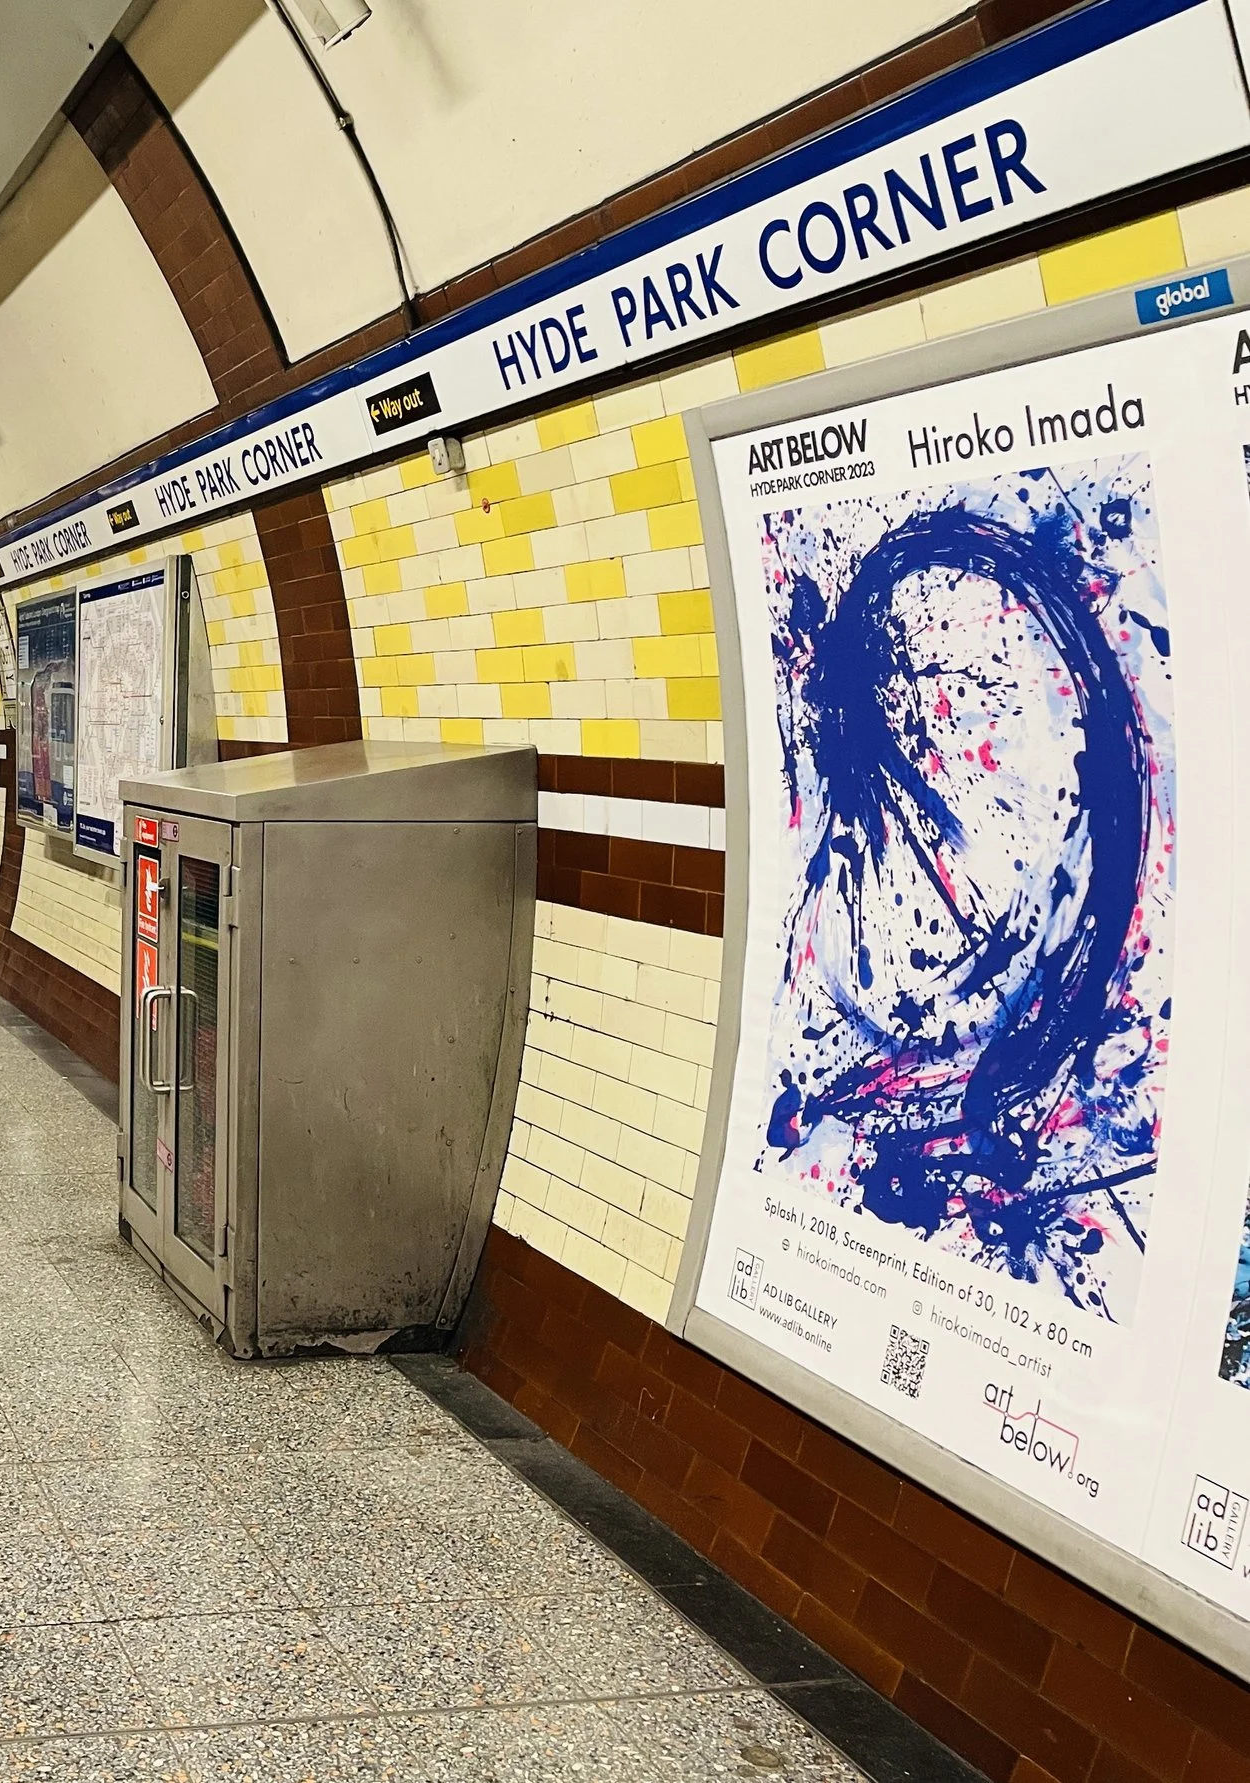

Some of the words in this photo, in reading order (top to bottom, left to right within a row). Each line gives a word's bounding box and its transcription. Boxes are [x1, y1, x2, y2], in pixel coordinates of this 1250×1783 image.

[493, 304, 598, 390] HYDE
[612, 245, 740, 348] PARK
[759, 118, 1048, 290] CORNER
[1156, 277, 1210, 316] global
[379, 399, 402, 421] Way
[403, 389, 424, 411] out
[908, 412, 1014, 468] Hiroko
[1026, 384, 1145, 446] Imada
[155, 476, 196, 518] HYDE
[196, 457, 241, 503] PARK
[242, 423, 323, 485] CORNER
[748, 437, 786, 475] ART
[787, 419, 868, 466] BELOW
[750, 482, 777, 498] HYDE
[777, 474, 802, 492] PARK
[803, 468, 846, 488] CORNER
[847, 461, 876, 480] 2023
[10, 545, 33, 574] HYDE
[31, 536, 55, 565] PARK
[53, 520, 92, 558] CORNER
[731, 1275, 748, 1300] lib
[737, 1256, 755, 1276] ad
[765, 1197, 797, 1224] Splash
[810, 1217, 838, 1245] 2018,
[843, 1231, 908, 1276] Screenprint,
[913, 1263, 954, 1295] Edition
[958, 1285, 972, 1303] of
[975, 1290, 996, 1317] 30,
[1004, 1303, 1029, 1328] 102
[1033, 1322, 1042, 1334] x
[1047, 1323, 1068, 1345] 80
[1072, 1339, 1093, 1358] cm
[797, 1242, 886, 1298] hirokoimada.com
[759, 1306, 832, 1353] www.adlib.online
[763, 1283, 777, 1298] AD
[779, 1290, 793, 1307] LIB
[794, 1299, 838, 1330] GALLERY
[930, 1305, 1052, 1377] hirokoimada_artist
[984, 1382, 1013, 1412] art
[1197, 1490, 1229, 1520] ad
[1187, 1513, 1218, 1551] lib
[1221, 1501, 1242, 1560] GALLERY
